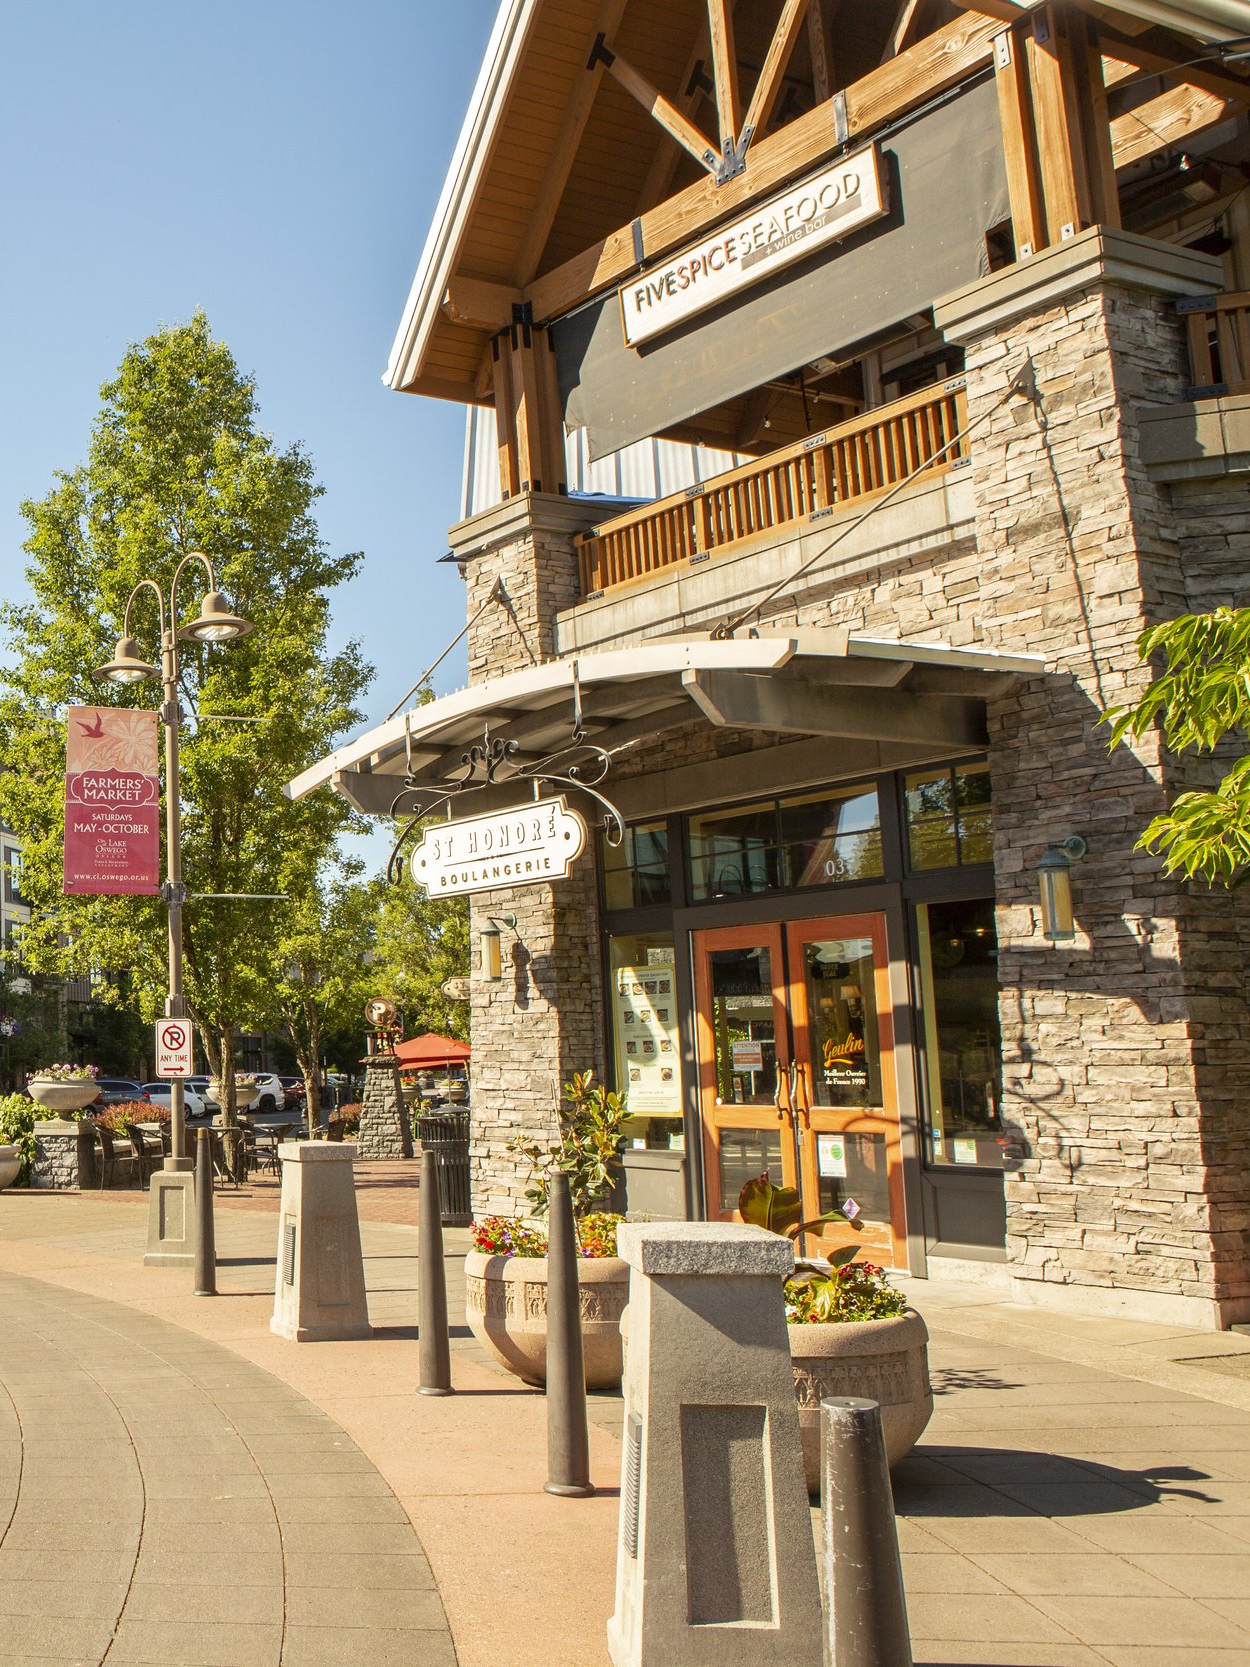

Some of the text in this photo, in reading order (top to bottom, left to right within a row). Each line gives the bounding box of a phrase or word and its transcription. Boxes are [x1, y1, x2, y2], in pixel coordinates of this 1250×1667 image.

[773, 230, 802, 250] wine
[805, 214, 828, 236] bar
[83, 788, 142, 801] MARKET
[92, 813, 133, 822] SATURDAYS
[432, 805, 556, 861] ST HONORÉ
[108, 839, 127, 847] LAKE
[440, 857, 551, 887] BOULANGERIE
[160, 1054, 189, 1062] ANY TIME
[851, 1077, 866, 1085] 1990
